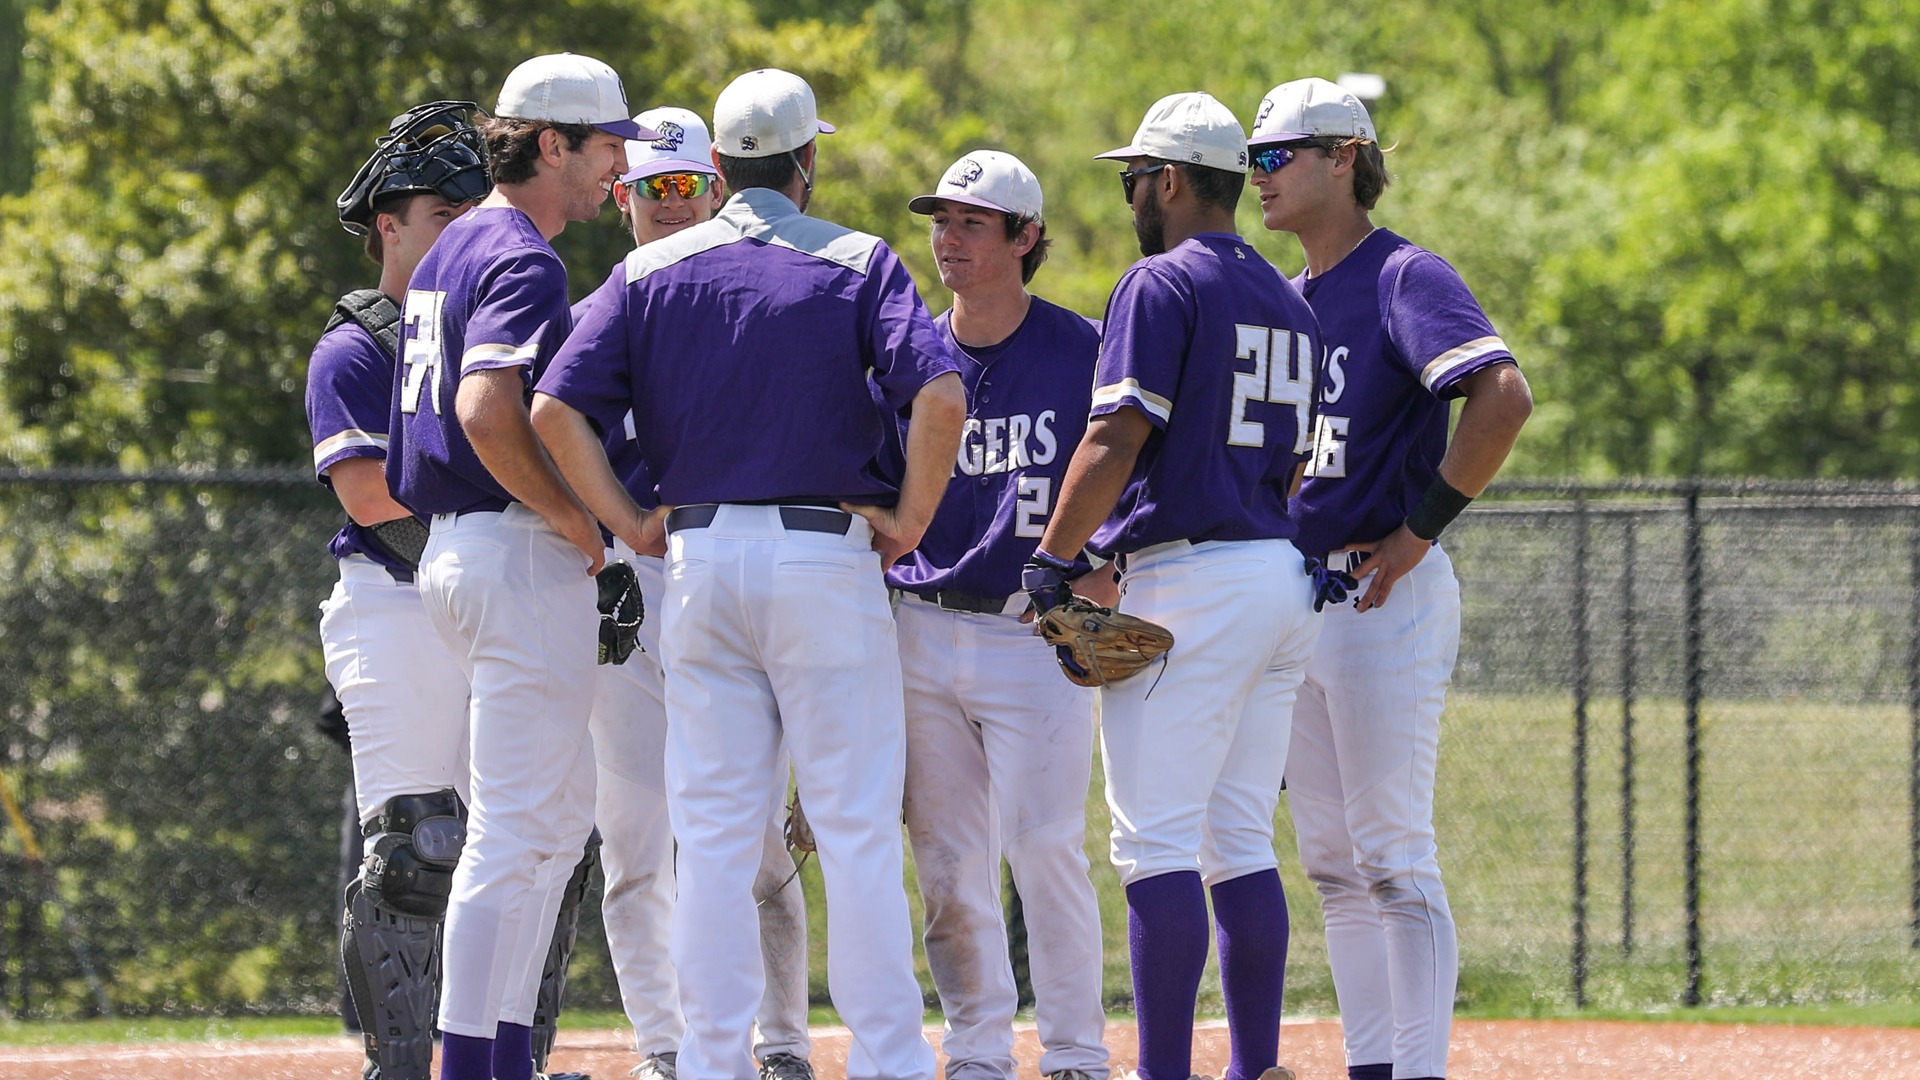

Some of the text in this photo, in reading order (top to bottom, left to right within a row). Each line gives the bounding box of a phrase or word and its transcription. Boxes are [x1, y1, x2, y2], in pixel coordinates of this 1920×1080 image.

[1227, 323, 1313, 456] 24
[1319, 344, 1351, 404] S
[952, 409, 1058, 478] GERS
[1015, 476, 1051, 538] 2
